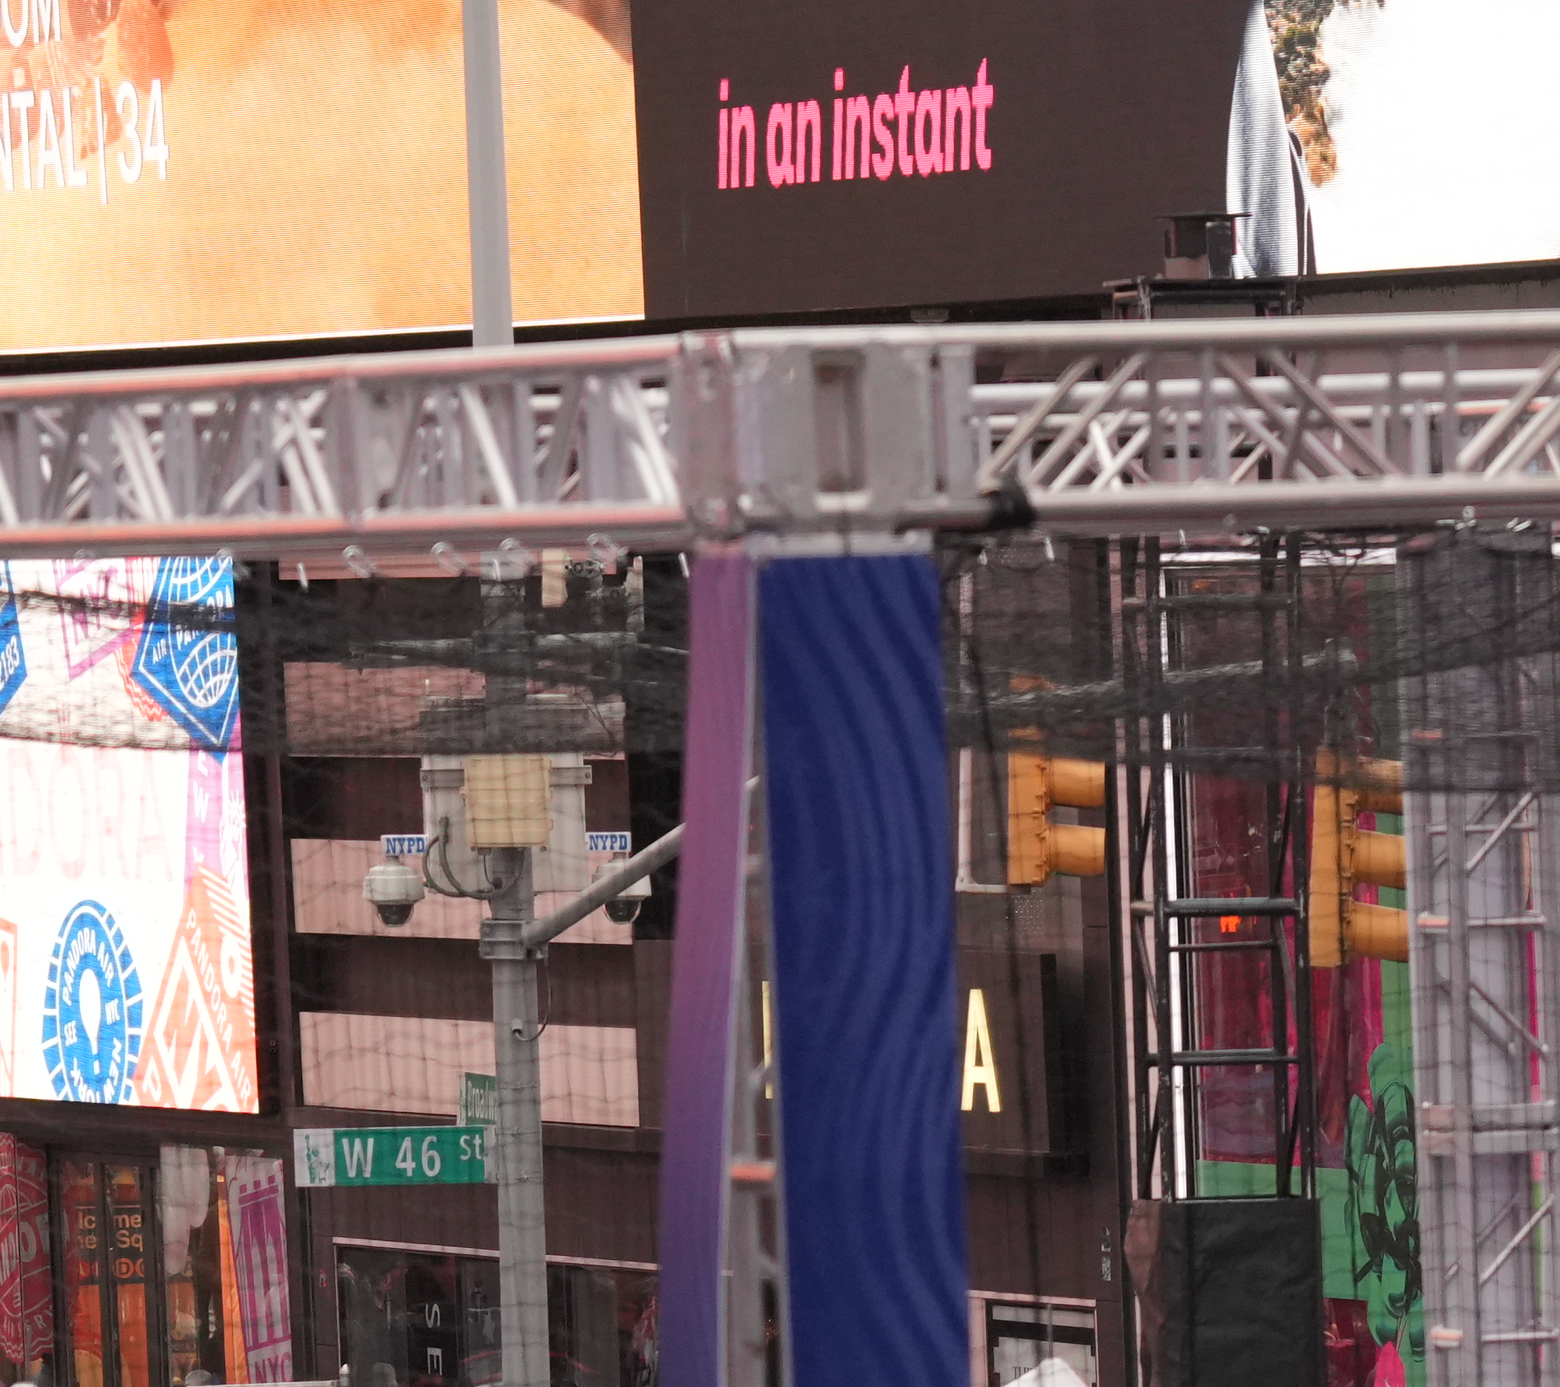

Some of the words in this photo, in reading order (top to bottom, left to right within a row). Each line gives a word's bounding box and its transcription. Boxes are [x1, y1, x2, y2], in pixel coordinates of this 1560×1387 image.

[116, 79, 170, 184] 34
[716, 77, 756, 190] in
[765, 98, 821, 188] an
[832, 57, 994, 181] instant
[151, 641, 168, 665] AIR
[385, 836, 426, 855] NYPD
[588, 833, 629, 851] NYPD
[61, 925, 97, 1003] PANDORA
[96, 950, 115, 988] AIR
[186, 907, 232, 1045] PANDORA
[64, 1020, 79, 1048] SEE
[341, 1136, 375, 1179] W
[394, 1134, 441, 1178] 46
[459, 1132, 485, 1162] St
